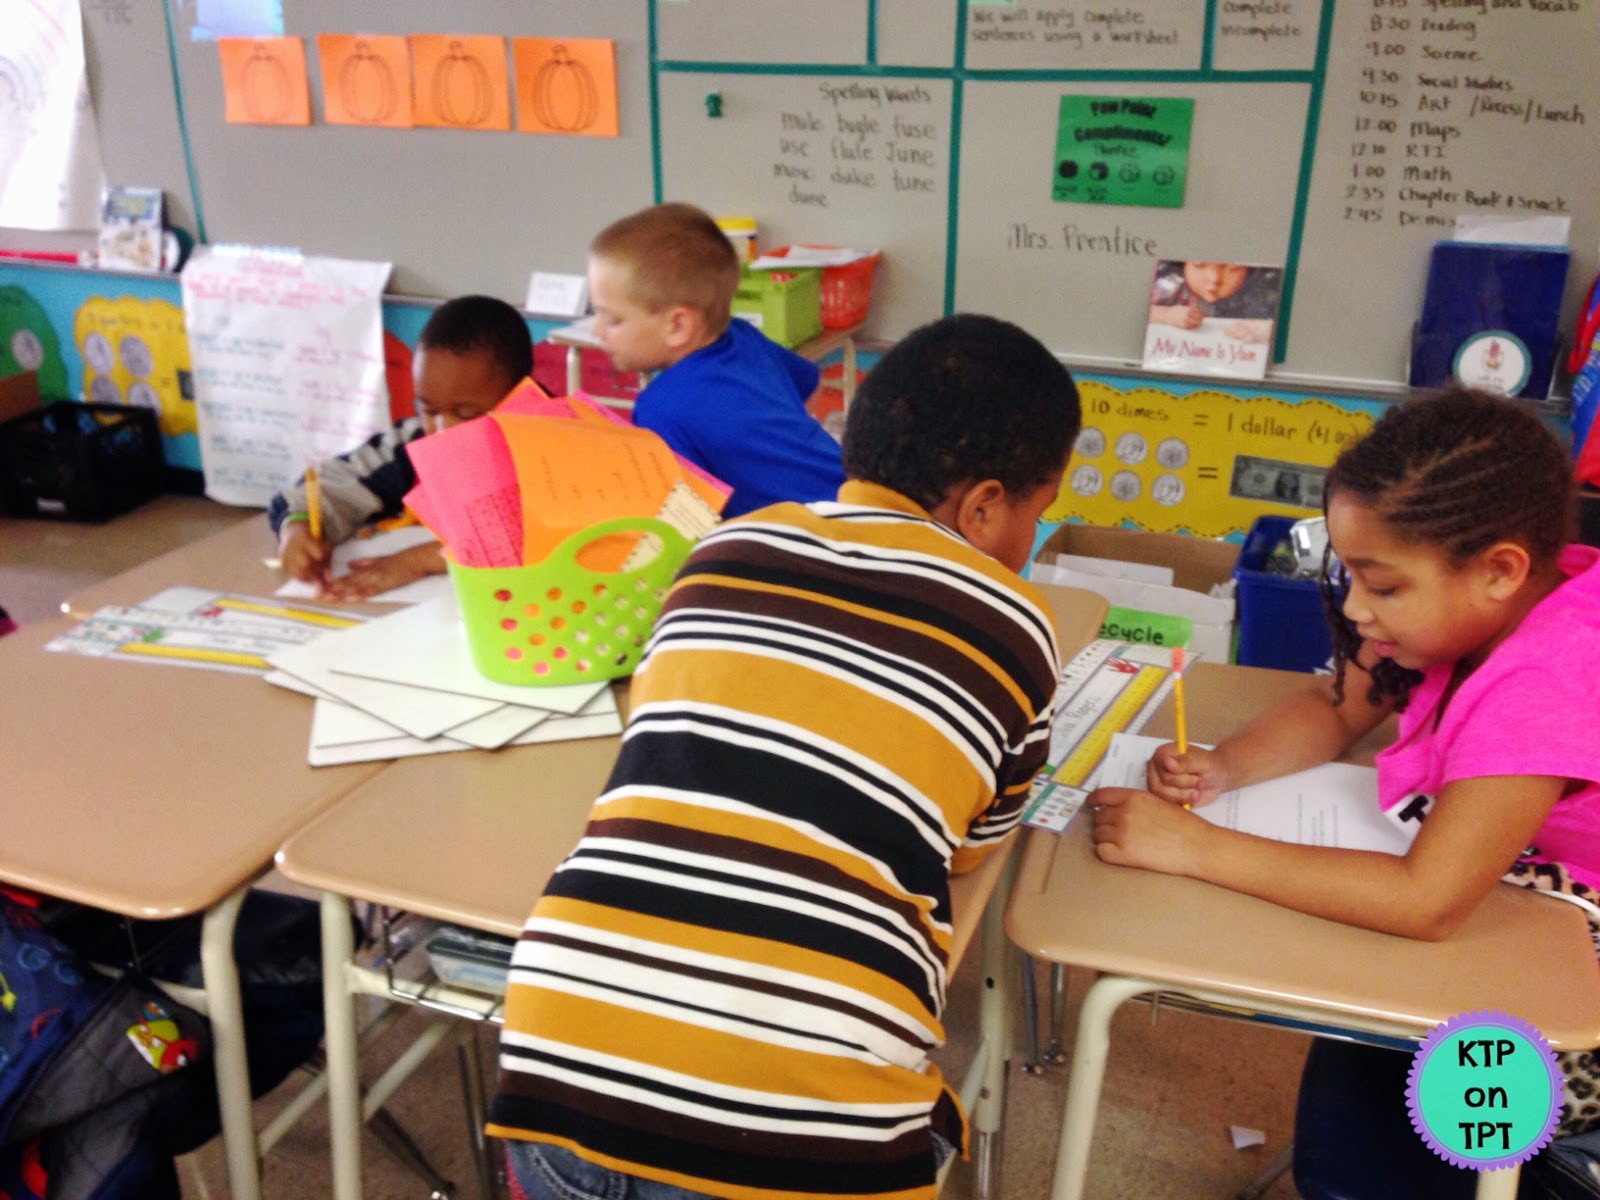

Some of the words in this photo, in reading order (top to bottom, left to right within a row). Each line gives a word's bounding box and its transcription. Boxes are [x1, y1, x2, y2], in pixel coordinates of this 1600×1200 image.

[1061, 223, 1157, 257] Prentice
[1151, 336, 1176, 358] My
[1177, 338, 1213, 358] Name
[1090, 399, 1111, 415] 10
[1115, 399, 1169, 422] dimes
[1240, 413, 1297, 439] dollar
[1098, 622, 1165, 646] ecycle
